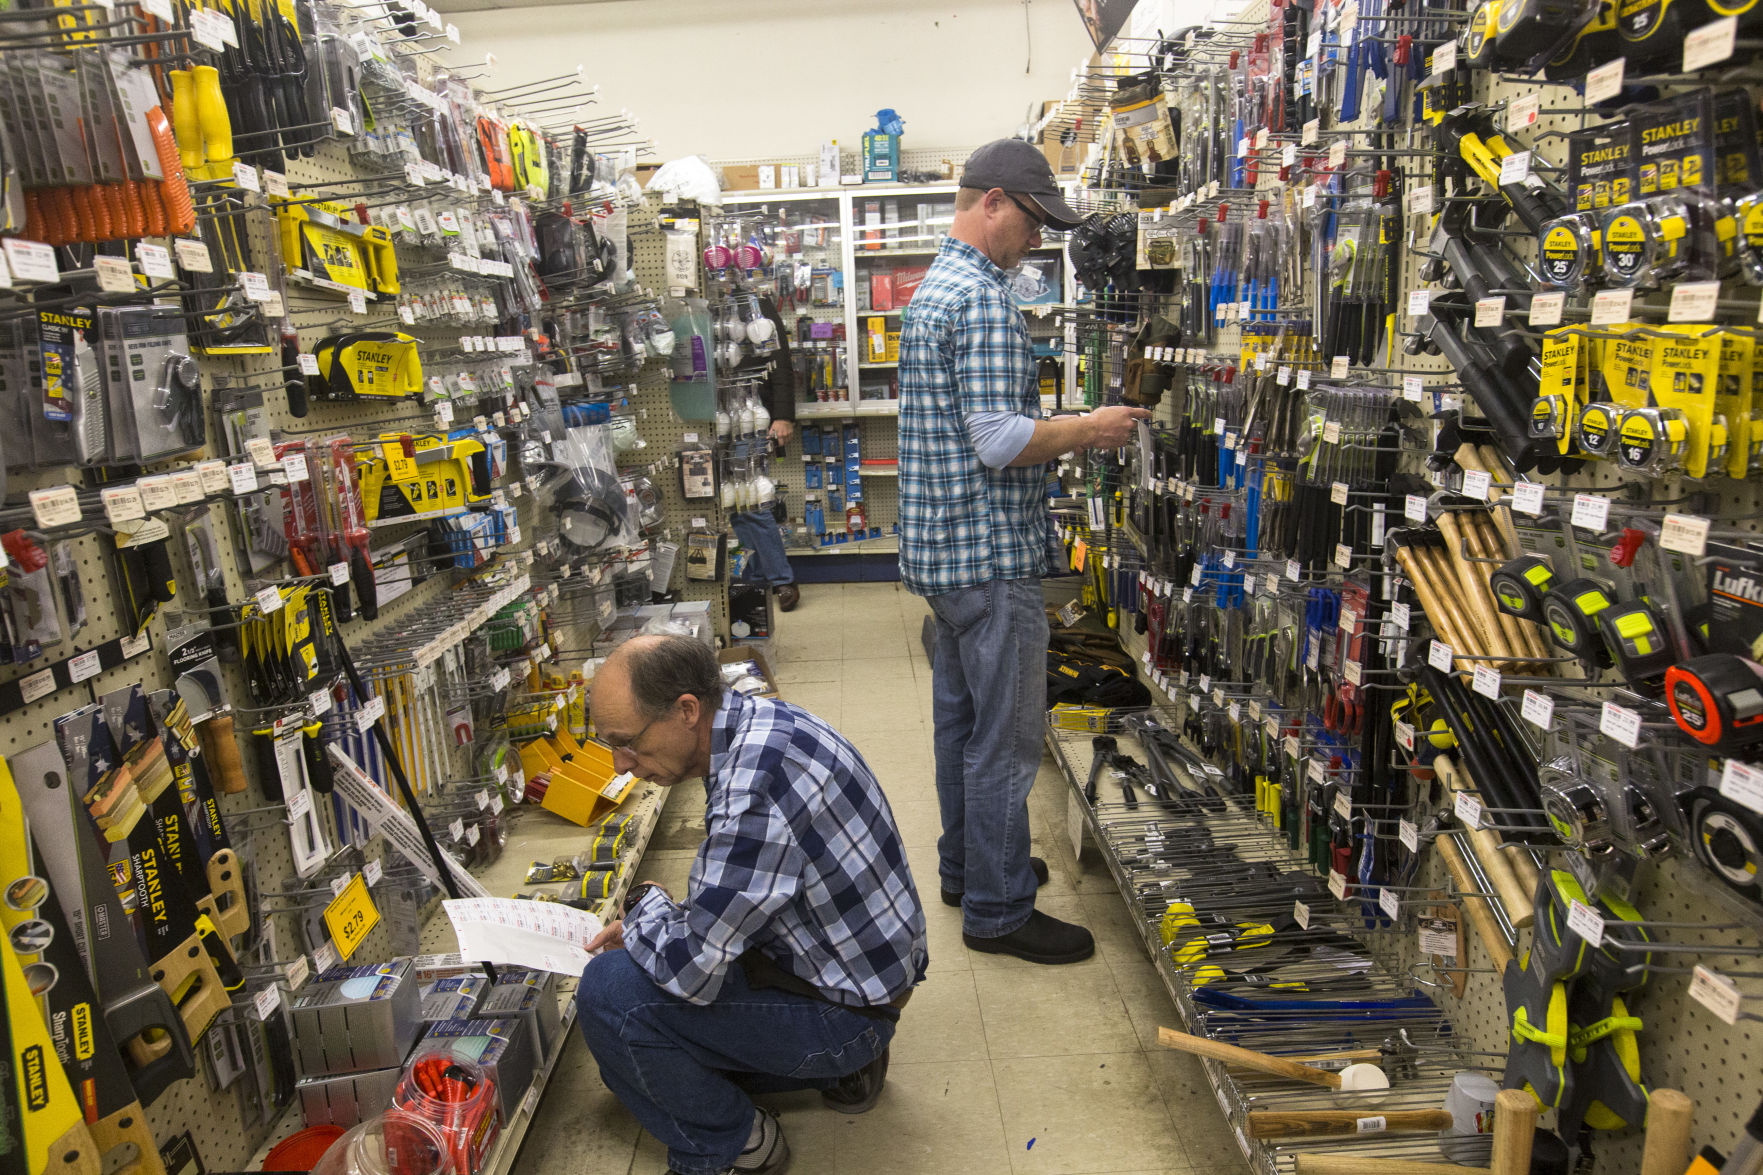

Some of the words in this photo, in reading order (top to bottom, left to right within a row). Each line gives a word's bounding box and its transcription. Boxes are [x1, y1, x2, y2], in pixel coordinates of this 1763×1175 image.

[1642, 117, 1700, 144] STANLEY
[1581, 145, 1630, 165] STANLEY
[1549, 240, 1571, 248] STANLEY
[1612, 231, 1637, 239] STANLEY
[40, 312, 92, 329] STANLEY
[357, 350, 393, 365] STANLEY
[1544, 345, 1575, 361] STANLEY
[1663, 347, 1709, 360] STANLEY
[1625, 427, 1648, 435] STANLEY
[393, 458, 408, 471] $2.79
[173, 653, 199, 665] FLOORING
[206, 798, 222, 836] STANLEY
[131, 853, 149, 908] SHARPTOOTH
[141, 848, 168, 921] STANLEY
[343, 909, 364, 940] $2.79
[52, 1011, 71, 1064] SharpTooth
[76, 1007, 90, 1054] STANLEY
[26, 1049, 45, 1106] STANLEY
